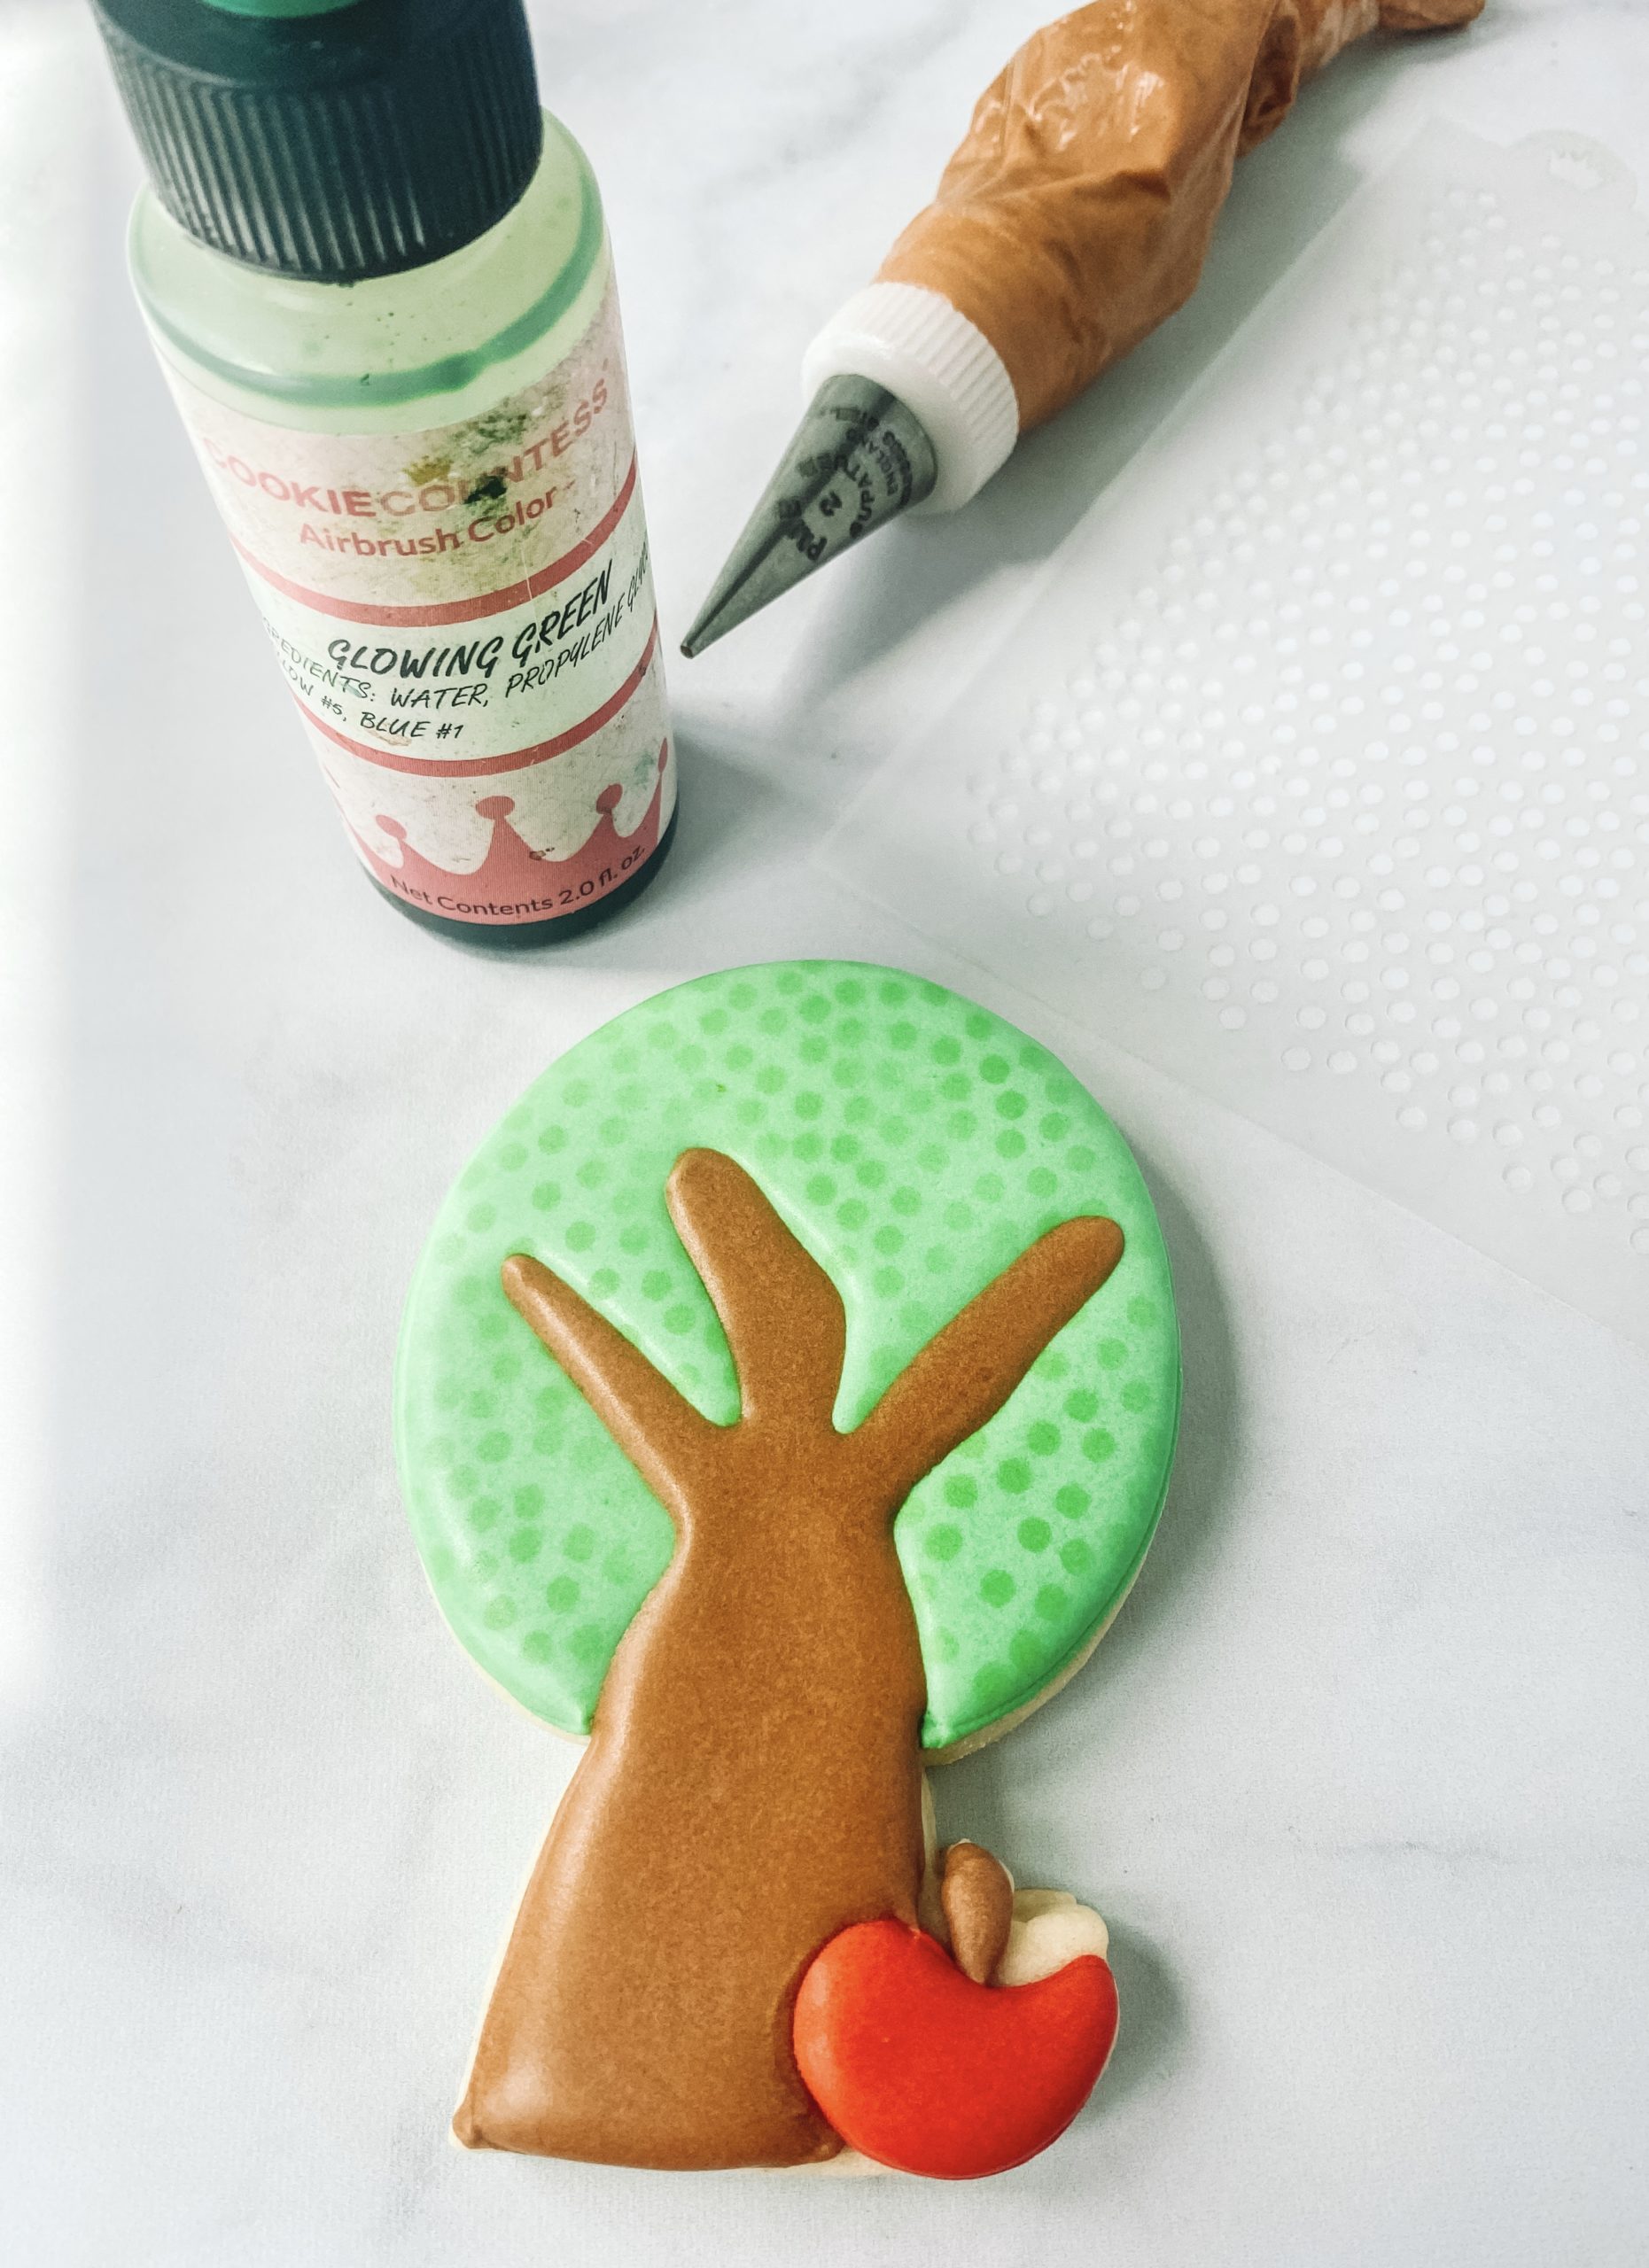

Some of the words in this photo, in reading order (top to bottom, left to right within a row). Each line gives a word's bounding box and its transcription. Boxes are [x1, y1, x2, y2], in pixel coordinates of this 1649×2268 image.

[299, 522, 461, 556] Airbrush
[467, 486, 557, 542] Color
[819, 490, 842, 517] 2
[328, 636, 503, 679] GLOWING
[511, 558, 613, 668] GREEN
[390, 684, 489, 709] WATER,
[504, 591, 626, 698] PROPYLENE
[321, 695, 347, 722] #5,
[360, 711, 431, 738] BLUE
[436, 722, 463, 740] #1
[390, 874, 432, 905] Net
[437, 895, 554, 916] Contents
[558, 880, 595, 906] 2.0
[597, 867, 618, 888] fl.
[621, 844, 646, 871] oz.
